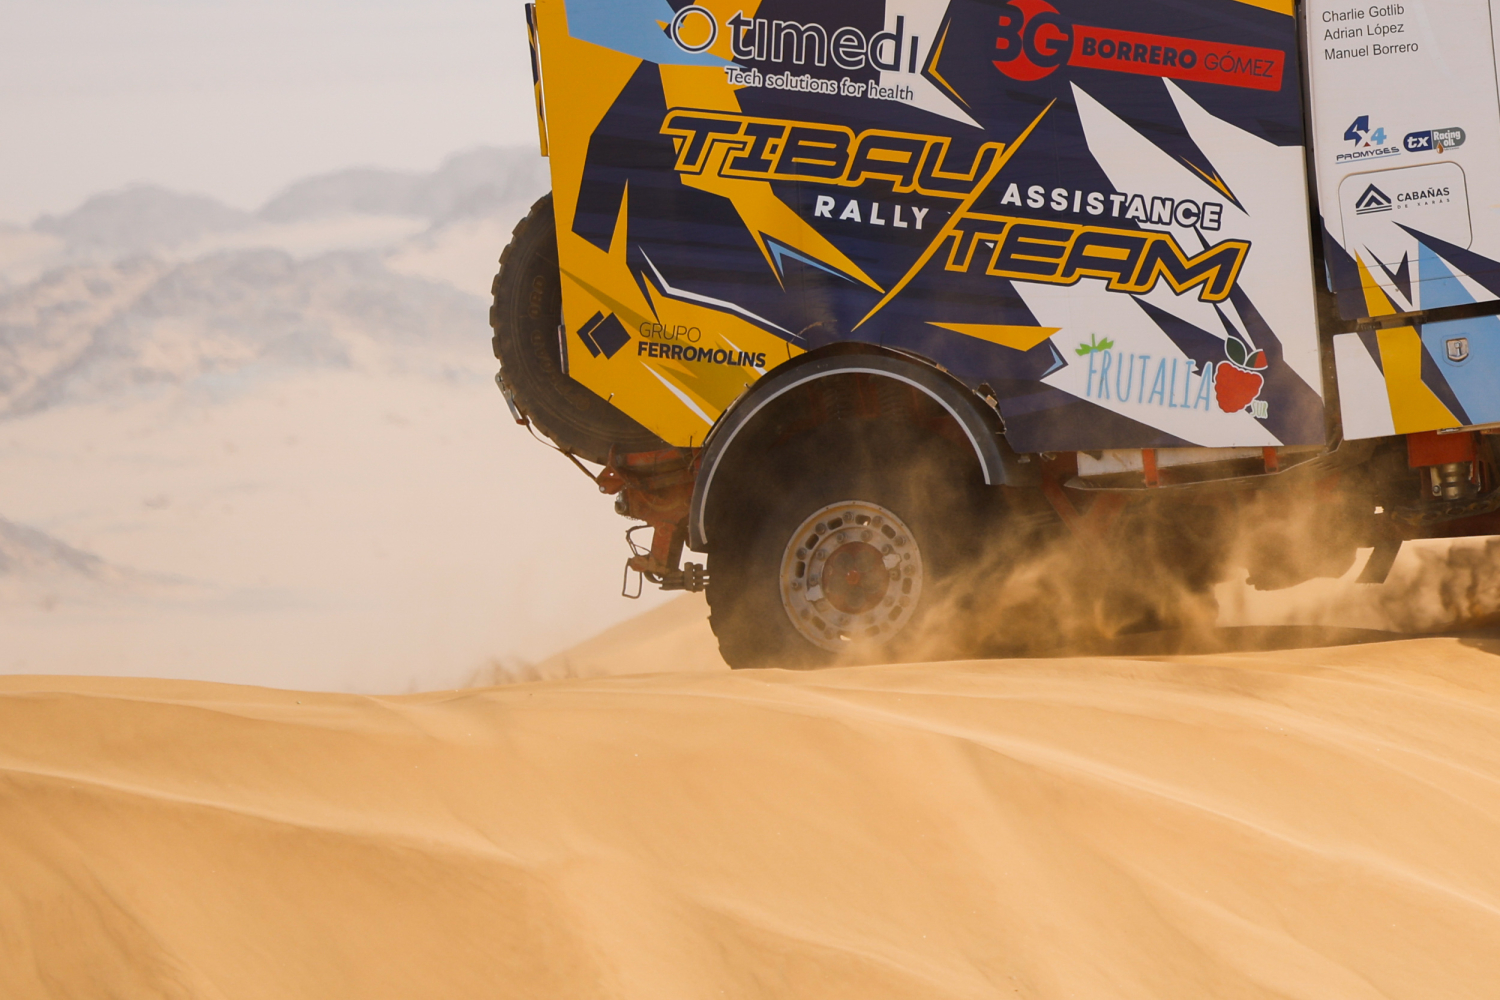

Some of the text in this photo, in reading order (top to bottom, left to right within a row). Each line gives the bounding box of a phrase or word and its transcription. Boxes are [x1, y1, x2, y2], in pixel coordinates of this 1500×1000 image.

[1322, 4, 1405, 22] Charlie Gotlib
[1324, 23, 1405, 41] Adrian López
[1082, 37, 1275, 78] BORRERO GÓMEZ
[1325, 43, 1419, 60] Manuel Borrero
[726, 67, 914, 100] Tech solutions for health
[1407, 130, 1460, 149] tx Racing
[659, 109, 1006, 199] TIBAU
[1336, 146, 1400, 161] PROMYGES
[1397, 187, 1450, 202] CABAÑAS
[814, 195, 929, 230] RALLY
[1001, 183, 1222, 230] ASSISTANCE
[945, 212, 1251, 303] TEAM
[639, 322, 701, 342] GRUPO
[638, 341, 766, 367] FERROMOLINS
[1087, 348, 1213, 411] FRUTALIA
[1251, 400, 1268, 419] SUR
